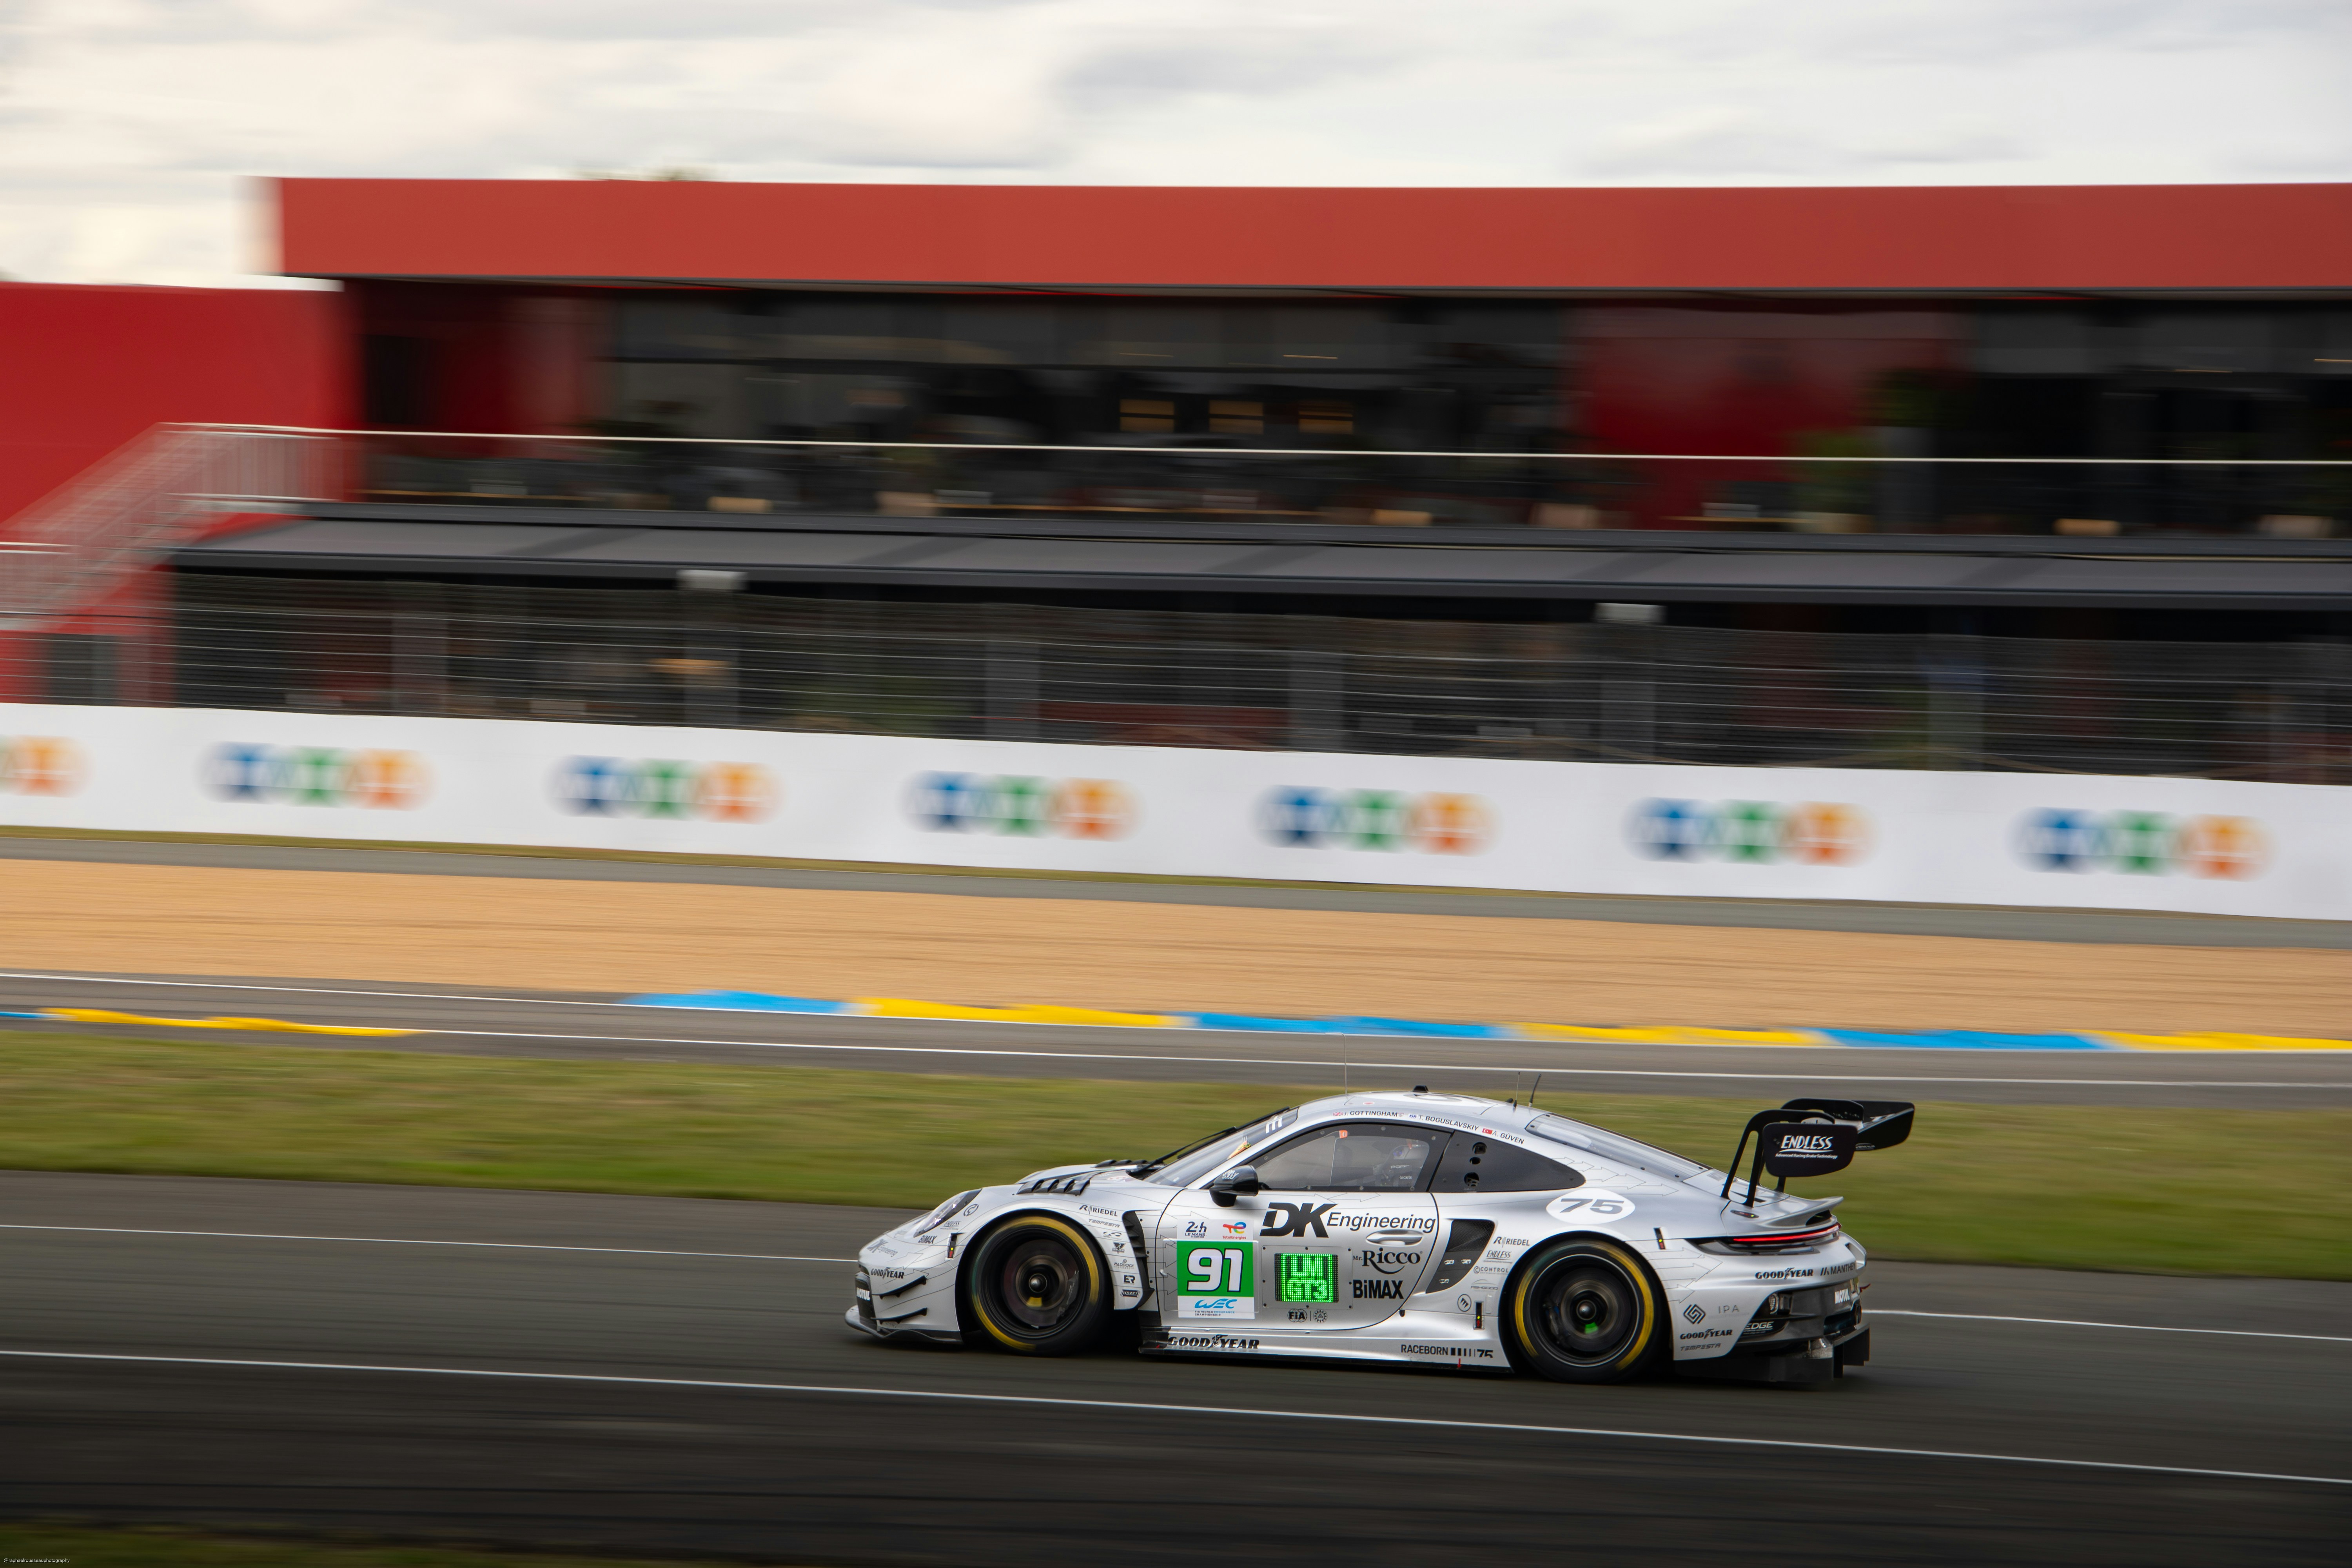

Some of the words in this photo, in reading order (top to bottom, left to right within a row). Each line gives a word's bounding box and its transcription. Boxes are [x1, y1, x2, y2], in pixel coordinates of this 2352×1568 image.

[1425, 1115, 1479, 1131] BOGUSLAVSKIY
[1500, 1133, 1524, 1144] GÜVEN
[1780, 1135, 1834, 1149] ENDLESS
[1093, 1207, 1118, 1217] RIEDEL
[1559, 1198, 1625, 1214] 75
[1089, 1219, 1120, 1228] TEMPESTA
[1259, 1202, 1339, 1238] DK
[1327, 1212, 1436, 1233] Engineering
[1361, 1247, 1421, 1274] Ricco
[1486, 1250, 1512, 1258] ENDLESS
[1187, 1248, 1244, 1292] 91
[1831, 1261, 1856, 1275] MANTHEY
[856, 1287, 871, 1301] MOTUL
[1287, 1279, 1327, 1300] GT3
[1353, 1279, 1404, 1299] BiMAX
[1835, 1288, 1850, 1304] MOTUL
[1194, 1298, 1238, 1309] WEC
[1718, 1305, 1740, 1314] IPA
[1401, 1344, 1448, 1355] RACEBORN
[1477, 1348, 1494, 1358] 75
[1680, 1343, 1721, 1351] TEMPESTA
